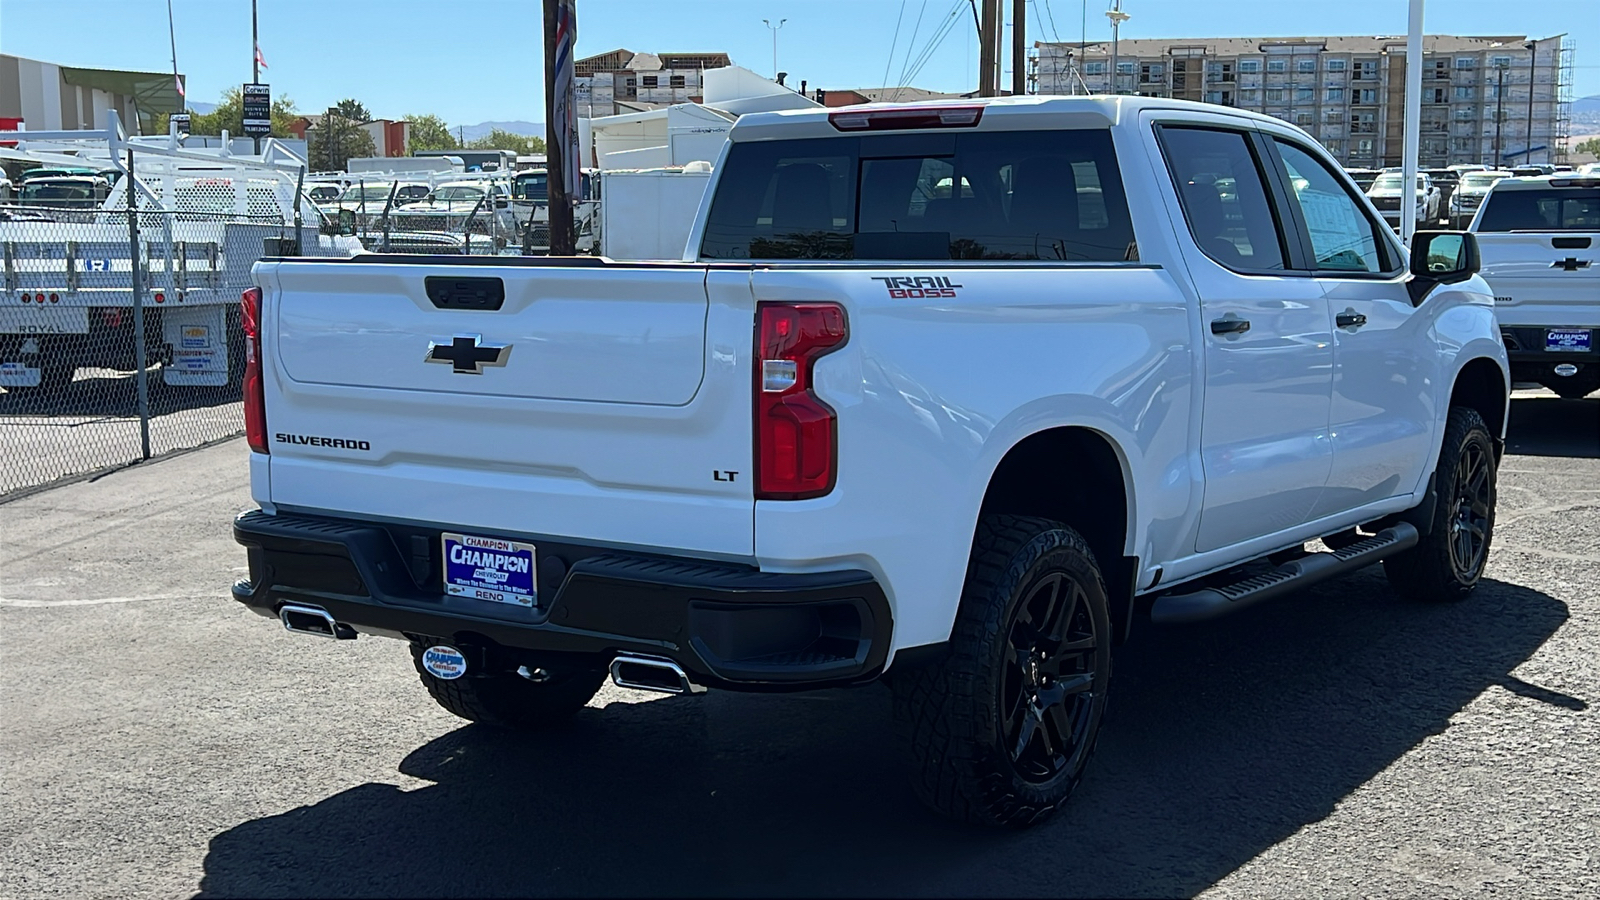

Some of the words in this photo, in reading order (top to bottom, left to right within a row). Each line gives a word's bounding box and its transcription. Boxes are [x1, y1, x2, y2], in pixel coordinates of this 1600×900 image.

[246, 86, 269, 94] Corwin
[482, 160, 499, 168] prime
[870, 276, 963, 288] TRAIL
[888, 288, 956, 299] BOSS
[19, 325, 64, 333] ROYAL
[1547, 332, 1588, 341] CHAMPION
[276, 433, 370, 450] SILVERADO
[713, 470, 739, 482] LT
[466, 537, 509, 551] CHAMPION
[450, 544, 529, 573] CHAMPION
[475, 570, 506, 580] CHEVROLET
[475, 590, 504, 601] RENO
